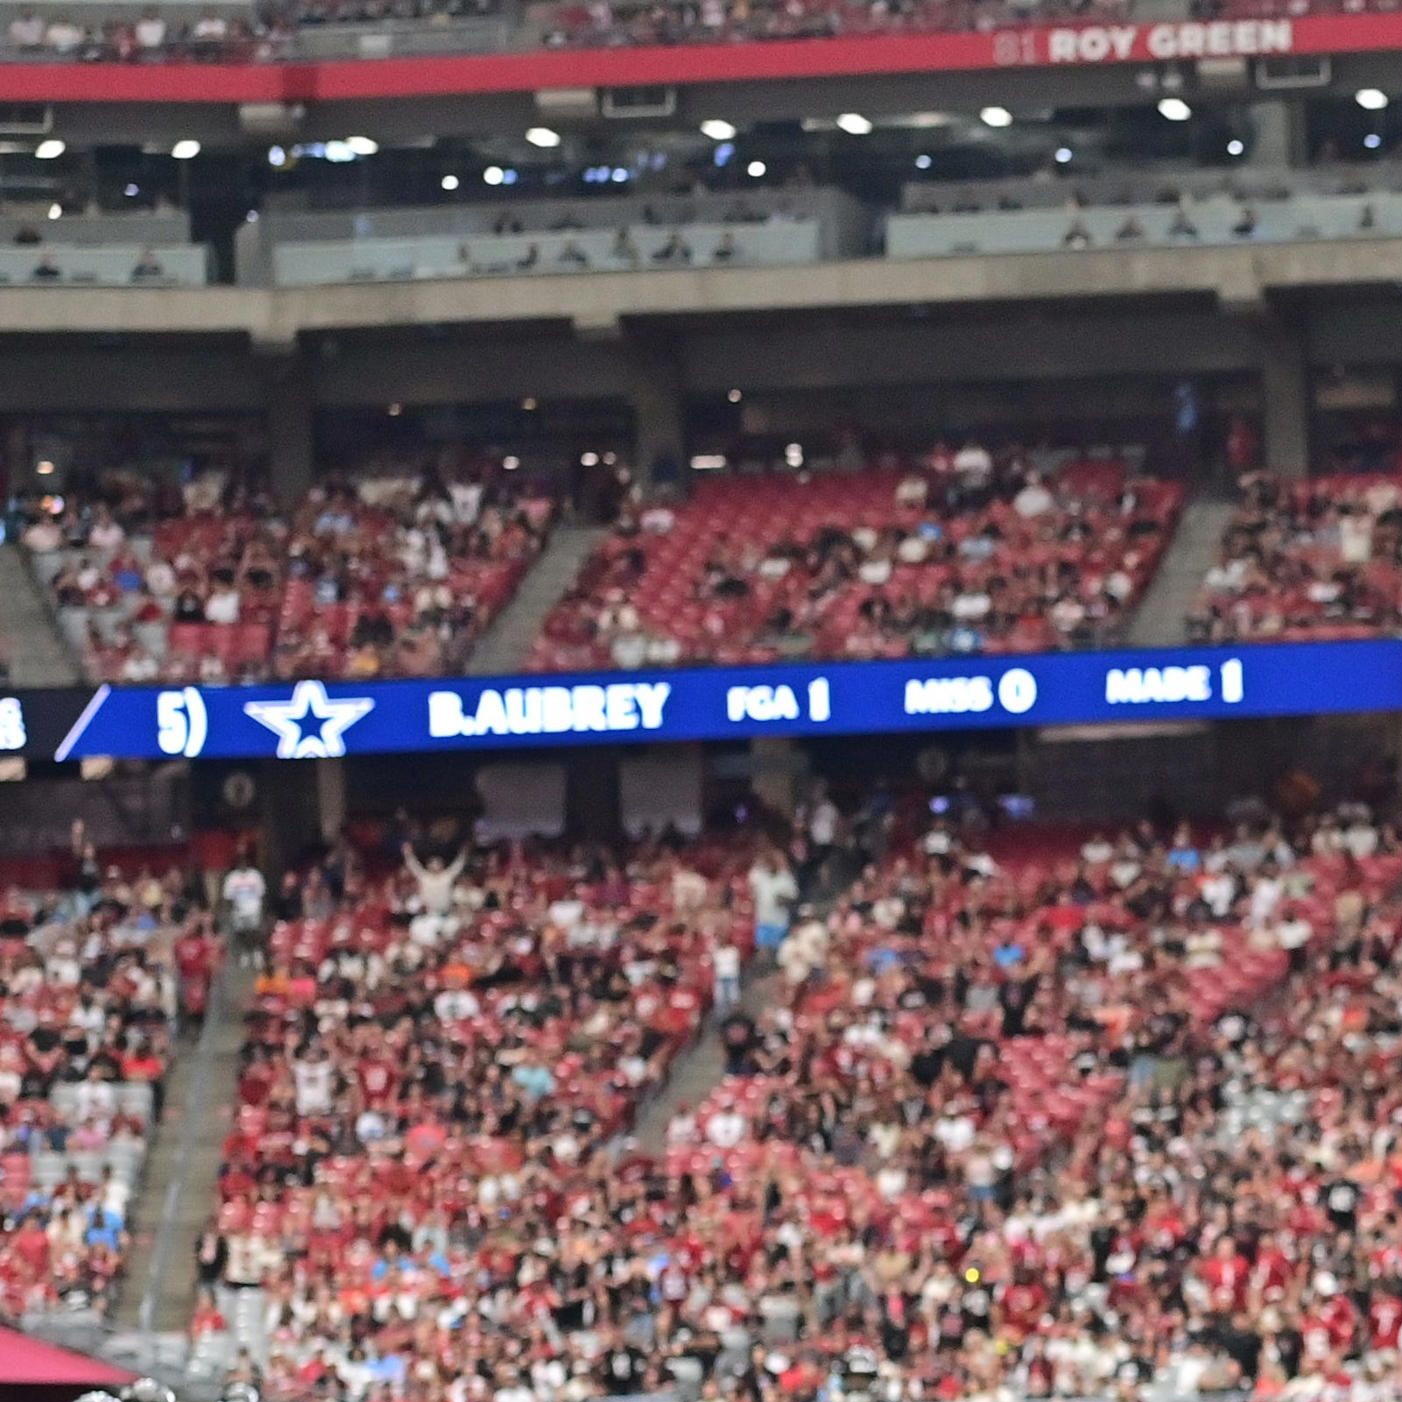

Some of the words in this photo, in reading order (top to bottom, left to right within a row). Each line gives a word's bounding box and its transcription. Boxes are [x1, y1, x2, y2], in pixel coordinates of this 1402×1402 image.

[1049, 26, 1137, 63] ROY
[1148, 19, 1293, 59] GREEN
[157, 686, 208, 757] 5)
[428, 682, 671, 738] B.AUBREY
[727, 685, 799, 722] FGA
[808, 676, 831, 722] 1
[905, 677, 993, 714] MISS
[998, 667, 1036, 713] 0
[1106, 665, 1211, 704] MADE
[1221, 659, 1243, 703] 1
